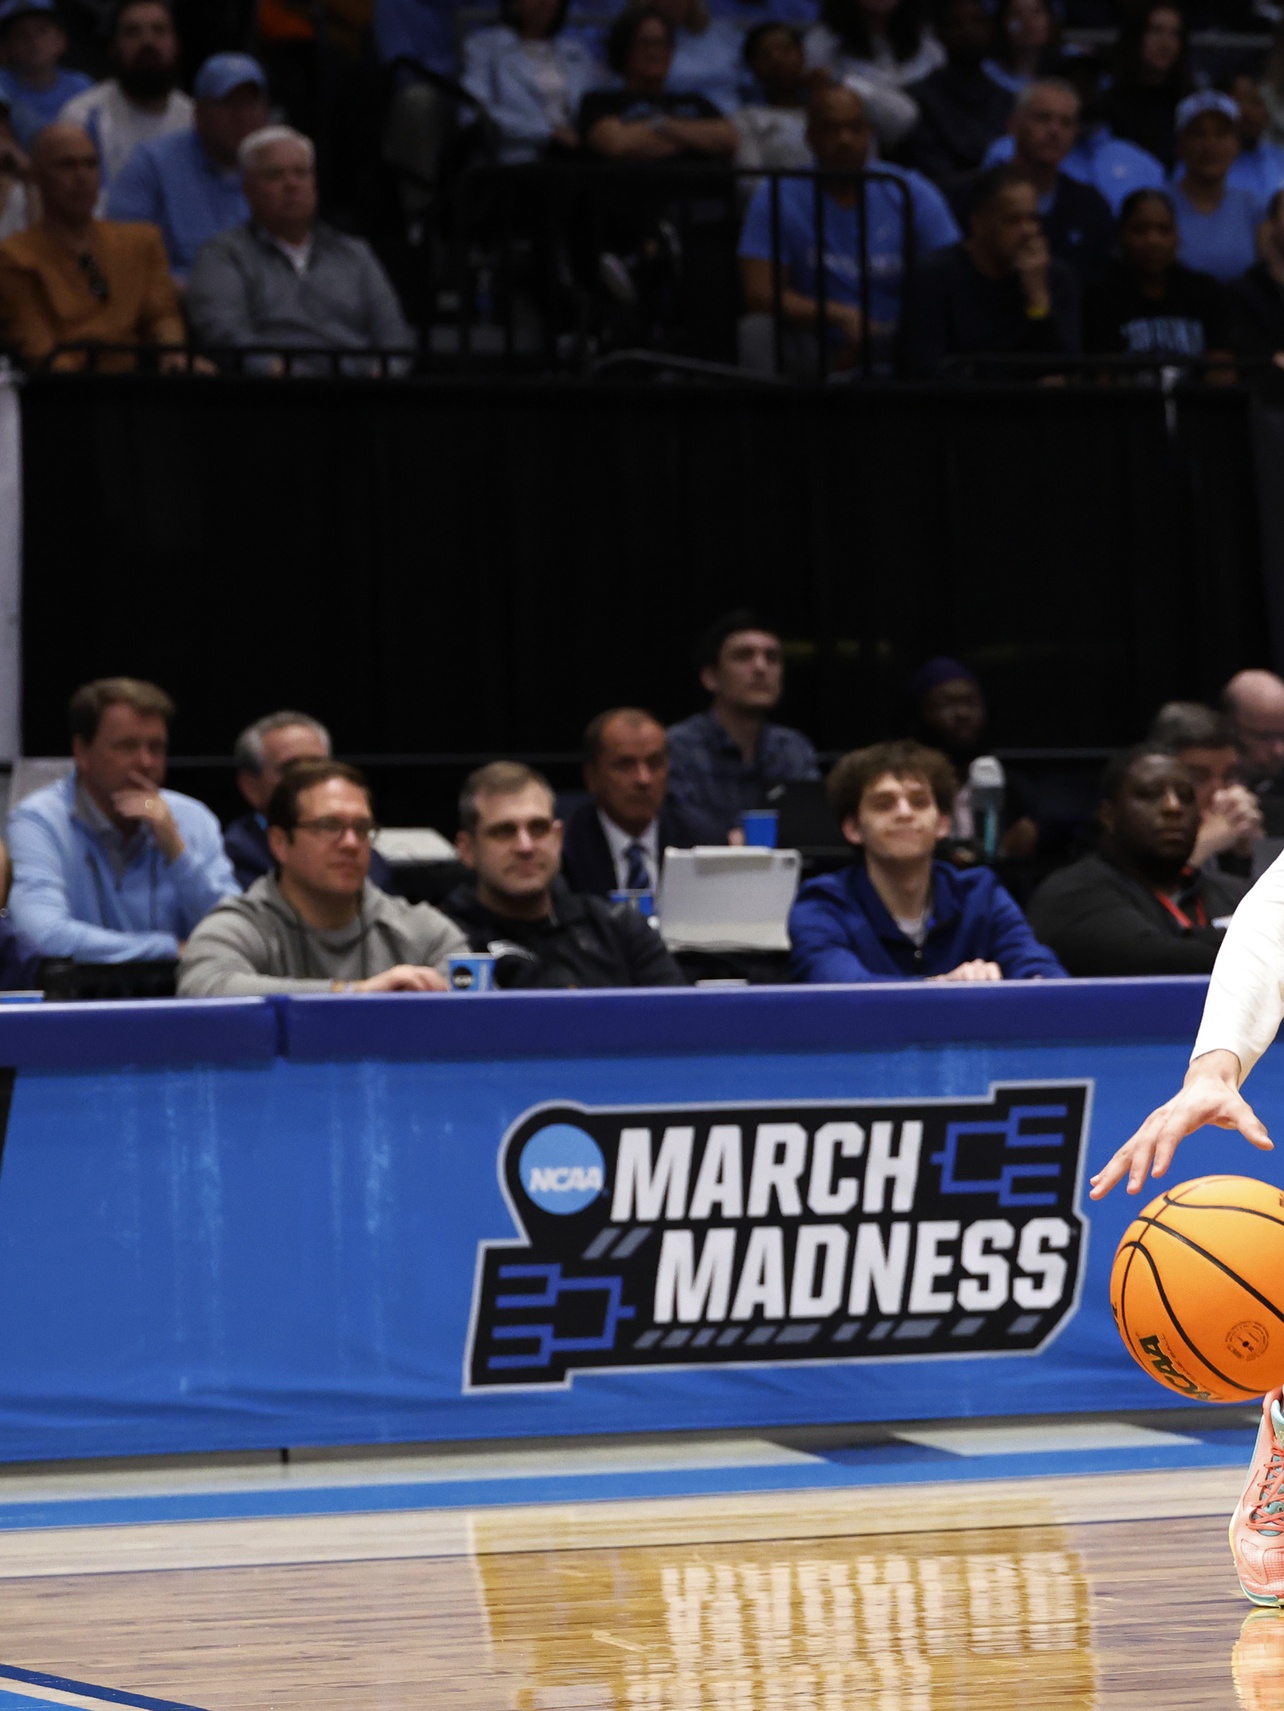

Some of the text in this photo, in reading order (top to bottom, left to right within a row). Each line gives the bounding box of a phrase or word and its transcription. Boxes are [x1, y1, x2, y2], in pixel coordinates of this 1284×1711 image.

[530, 1166, 604, 1193] NCAA
[610, 1120, 923, 1222] MARCH
[653, 1217, 1071, 1324] MADNESS
